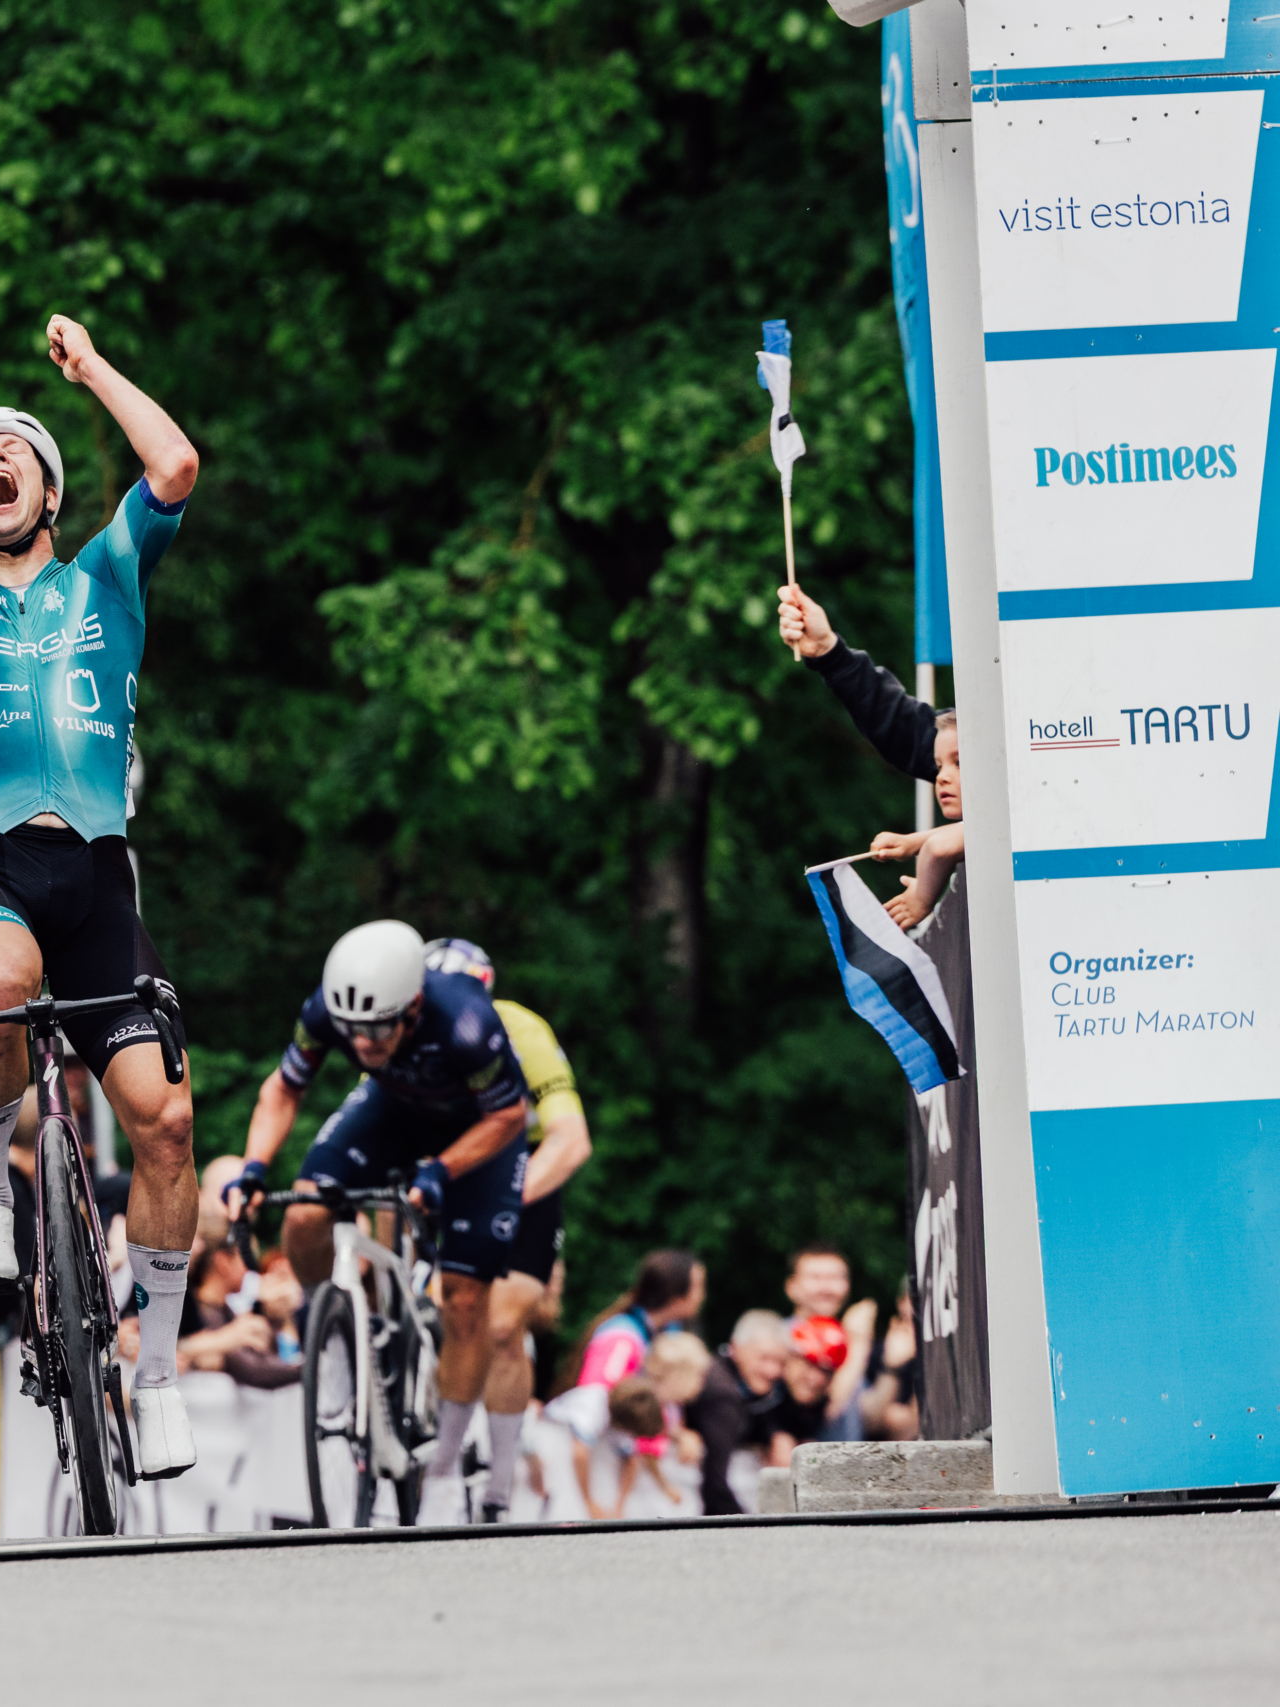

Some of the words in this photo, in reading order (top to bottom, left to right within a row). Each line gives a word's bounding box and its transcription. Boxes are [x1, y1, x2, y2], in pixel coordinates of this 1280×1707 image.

[999, 196, 1081, 233] visit
[1090, 190, 1231, 229] estonia
[1034, 442, 1238, 488] Postimees
[75, 639, 106, 654] KOMANDA
[52, 716, 116, 740] VILNIUS
[1029, 715, 1093, 740] hotell
[1120, 702, 1251, 746] TARTU
[1048, 948, 1195, 980] Organizer:
[150, 1259, 175, 1270] AERO
